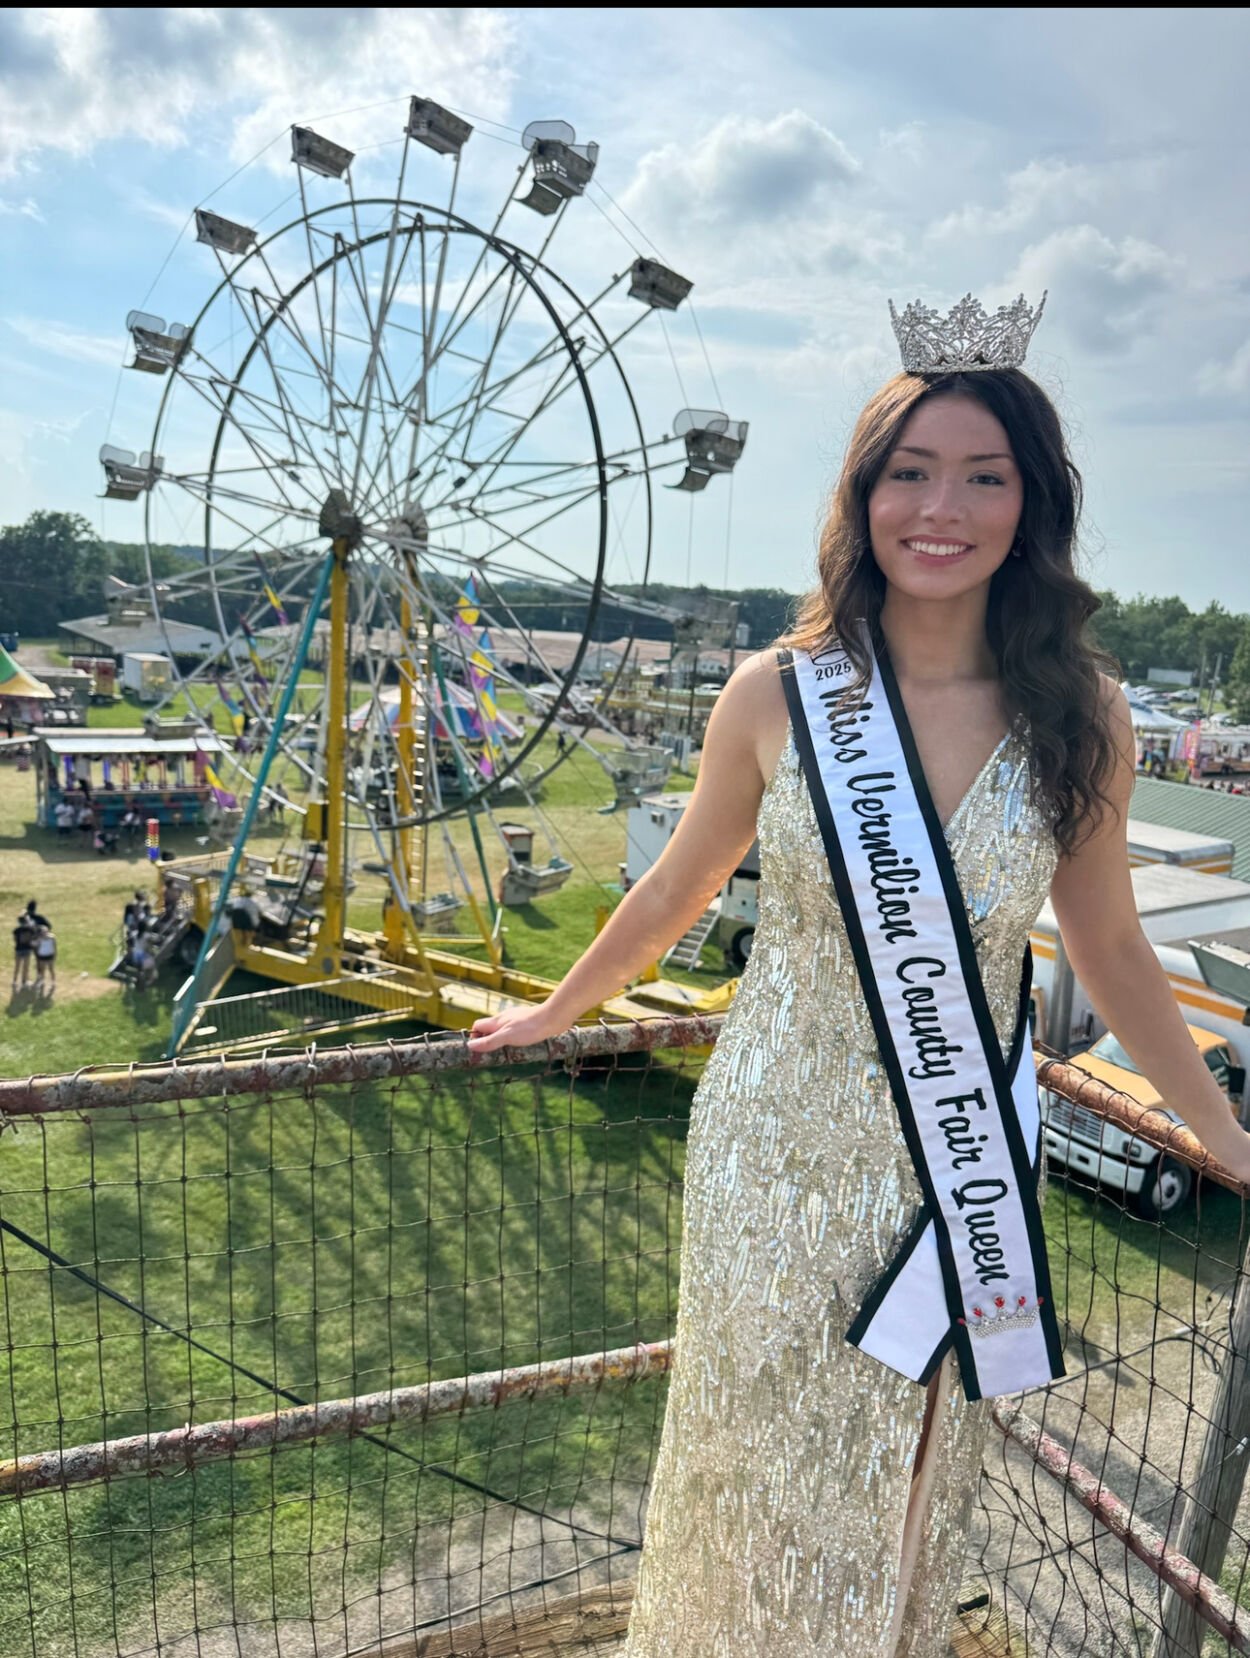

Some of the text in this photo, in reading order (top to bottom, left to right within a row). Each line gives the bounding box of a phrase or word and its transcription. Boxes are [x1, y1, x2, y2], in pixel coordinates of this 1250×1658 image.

[815, 662, 852, 681] 2025
[819, 682, 1010, 1286] Miss Vermilion County Fair Queen
